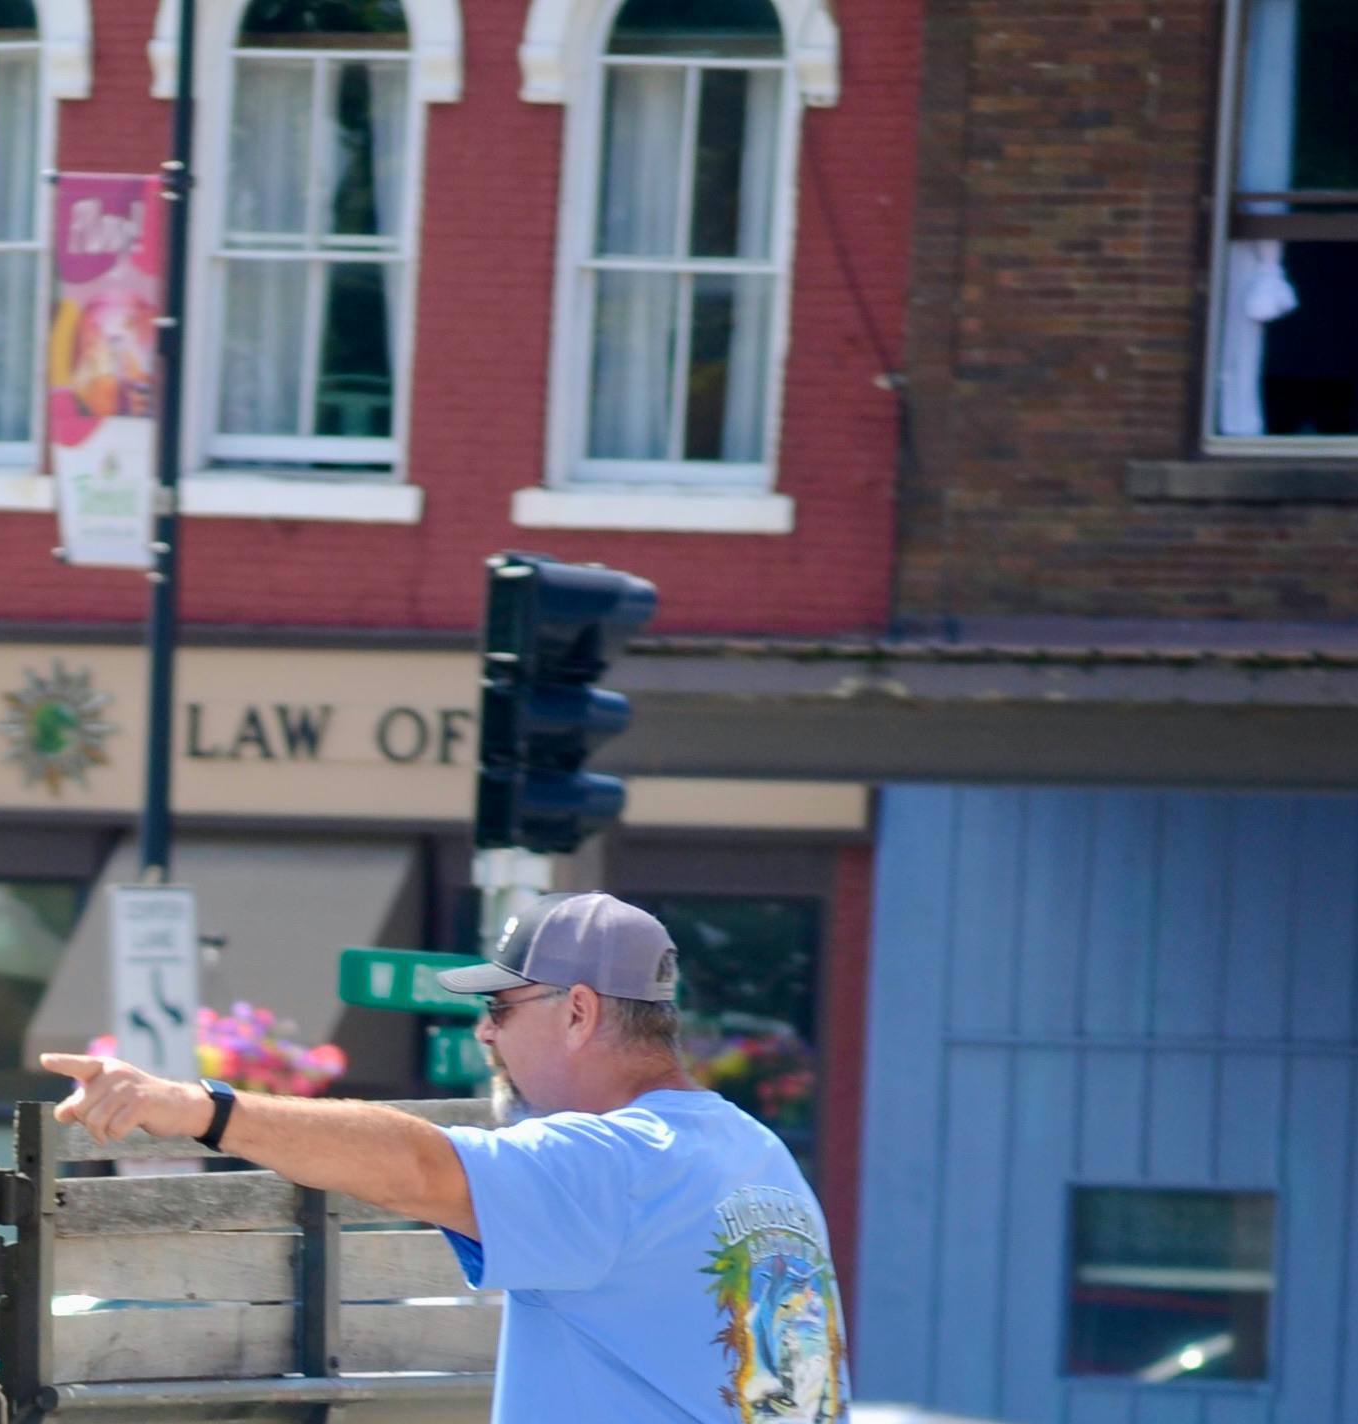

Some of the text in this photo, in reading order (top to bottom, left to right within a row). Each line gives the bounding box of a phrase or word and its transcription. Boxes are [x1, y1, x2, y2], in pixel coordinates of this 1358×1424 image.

[185, 702, 475, 766] LAW OF
[370, 962, 394, 999] W
